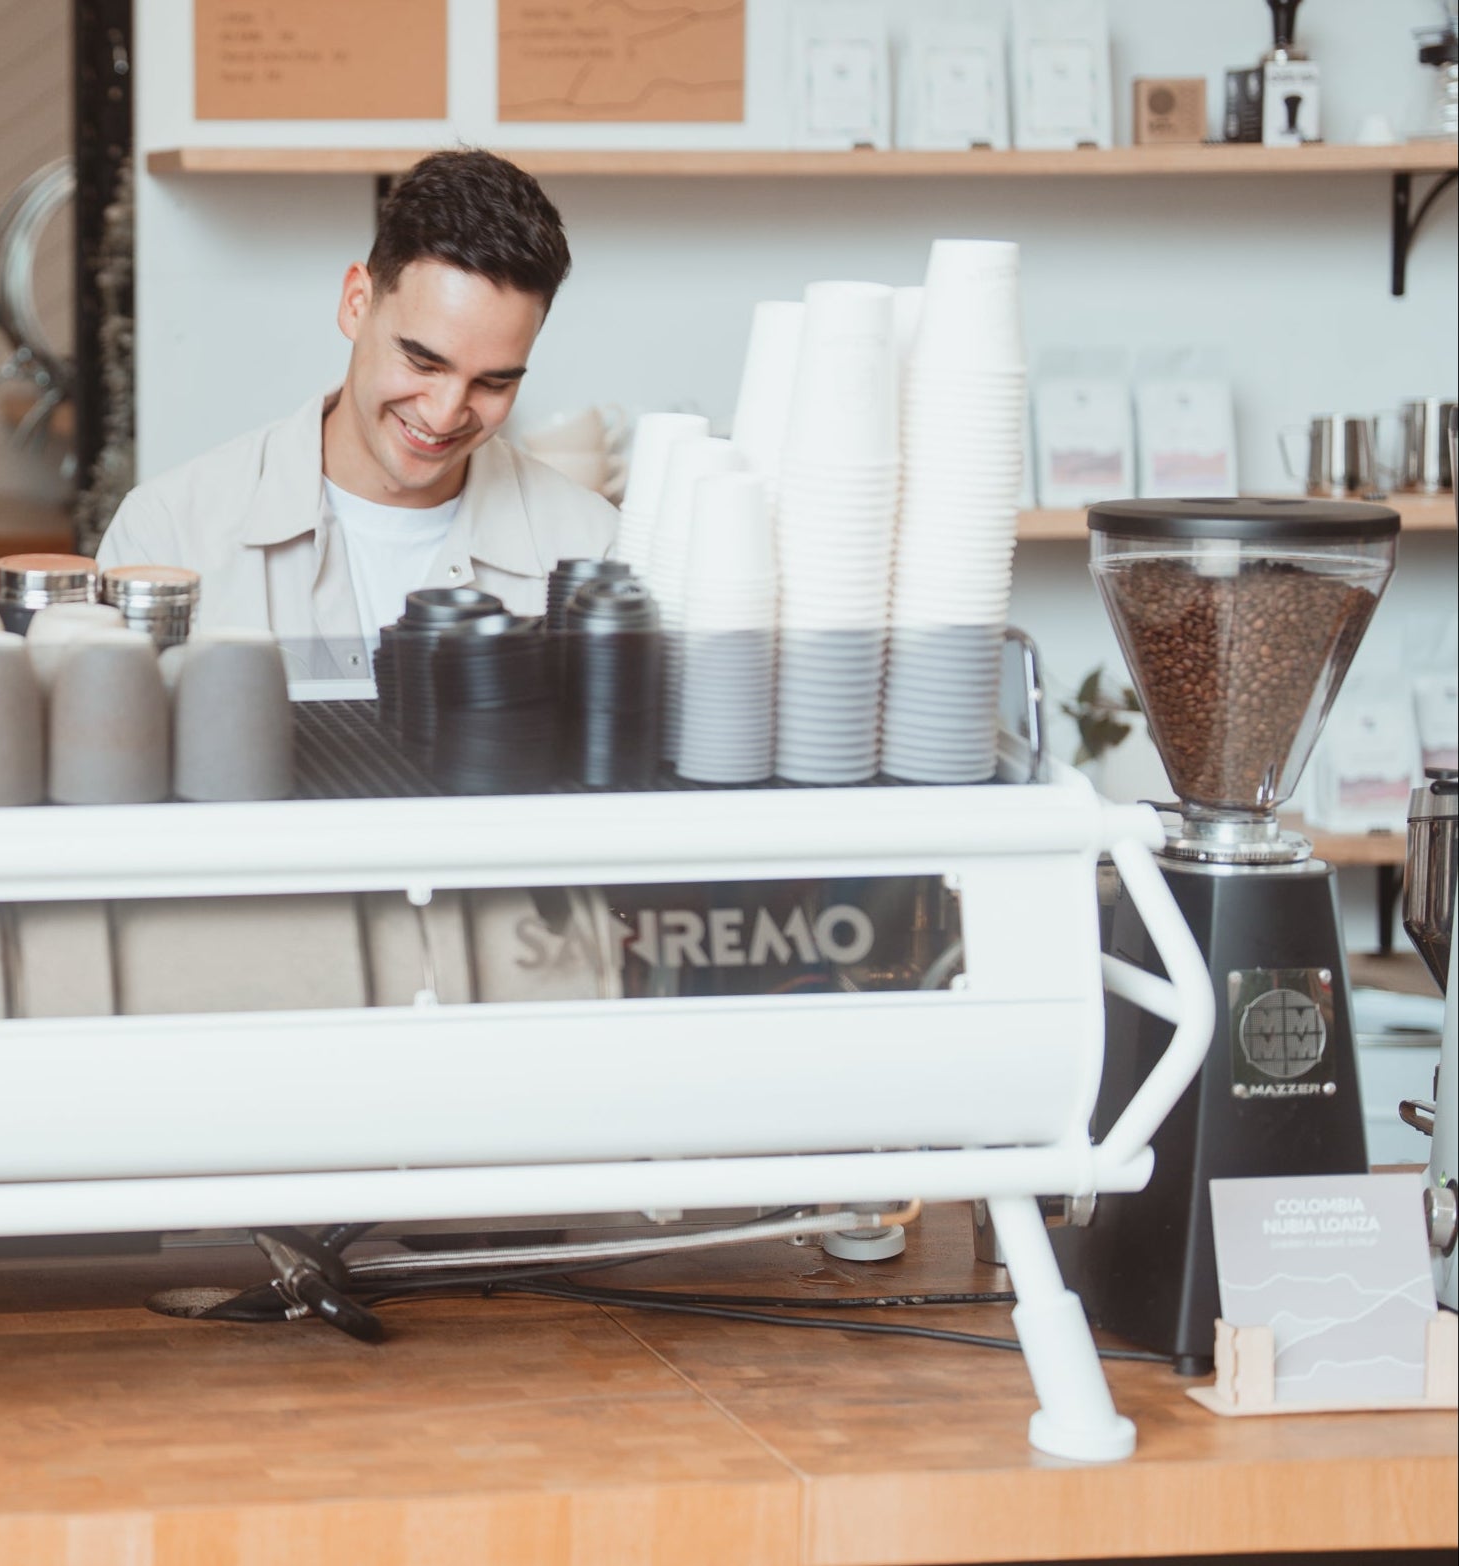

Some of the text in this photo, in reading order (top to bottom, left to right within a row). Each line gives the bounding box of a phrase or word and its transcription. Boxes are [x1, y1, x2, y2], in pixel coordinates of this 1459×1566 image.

[515, 904, 874, 970] SANREMO
[1249, 1083, 1320, 1096] MAZZER
[1274, 1196, 1365, 1215] COLOMBIA
[1262, 1216, 1381, 1235] NUBIA LOAIZA
